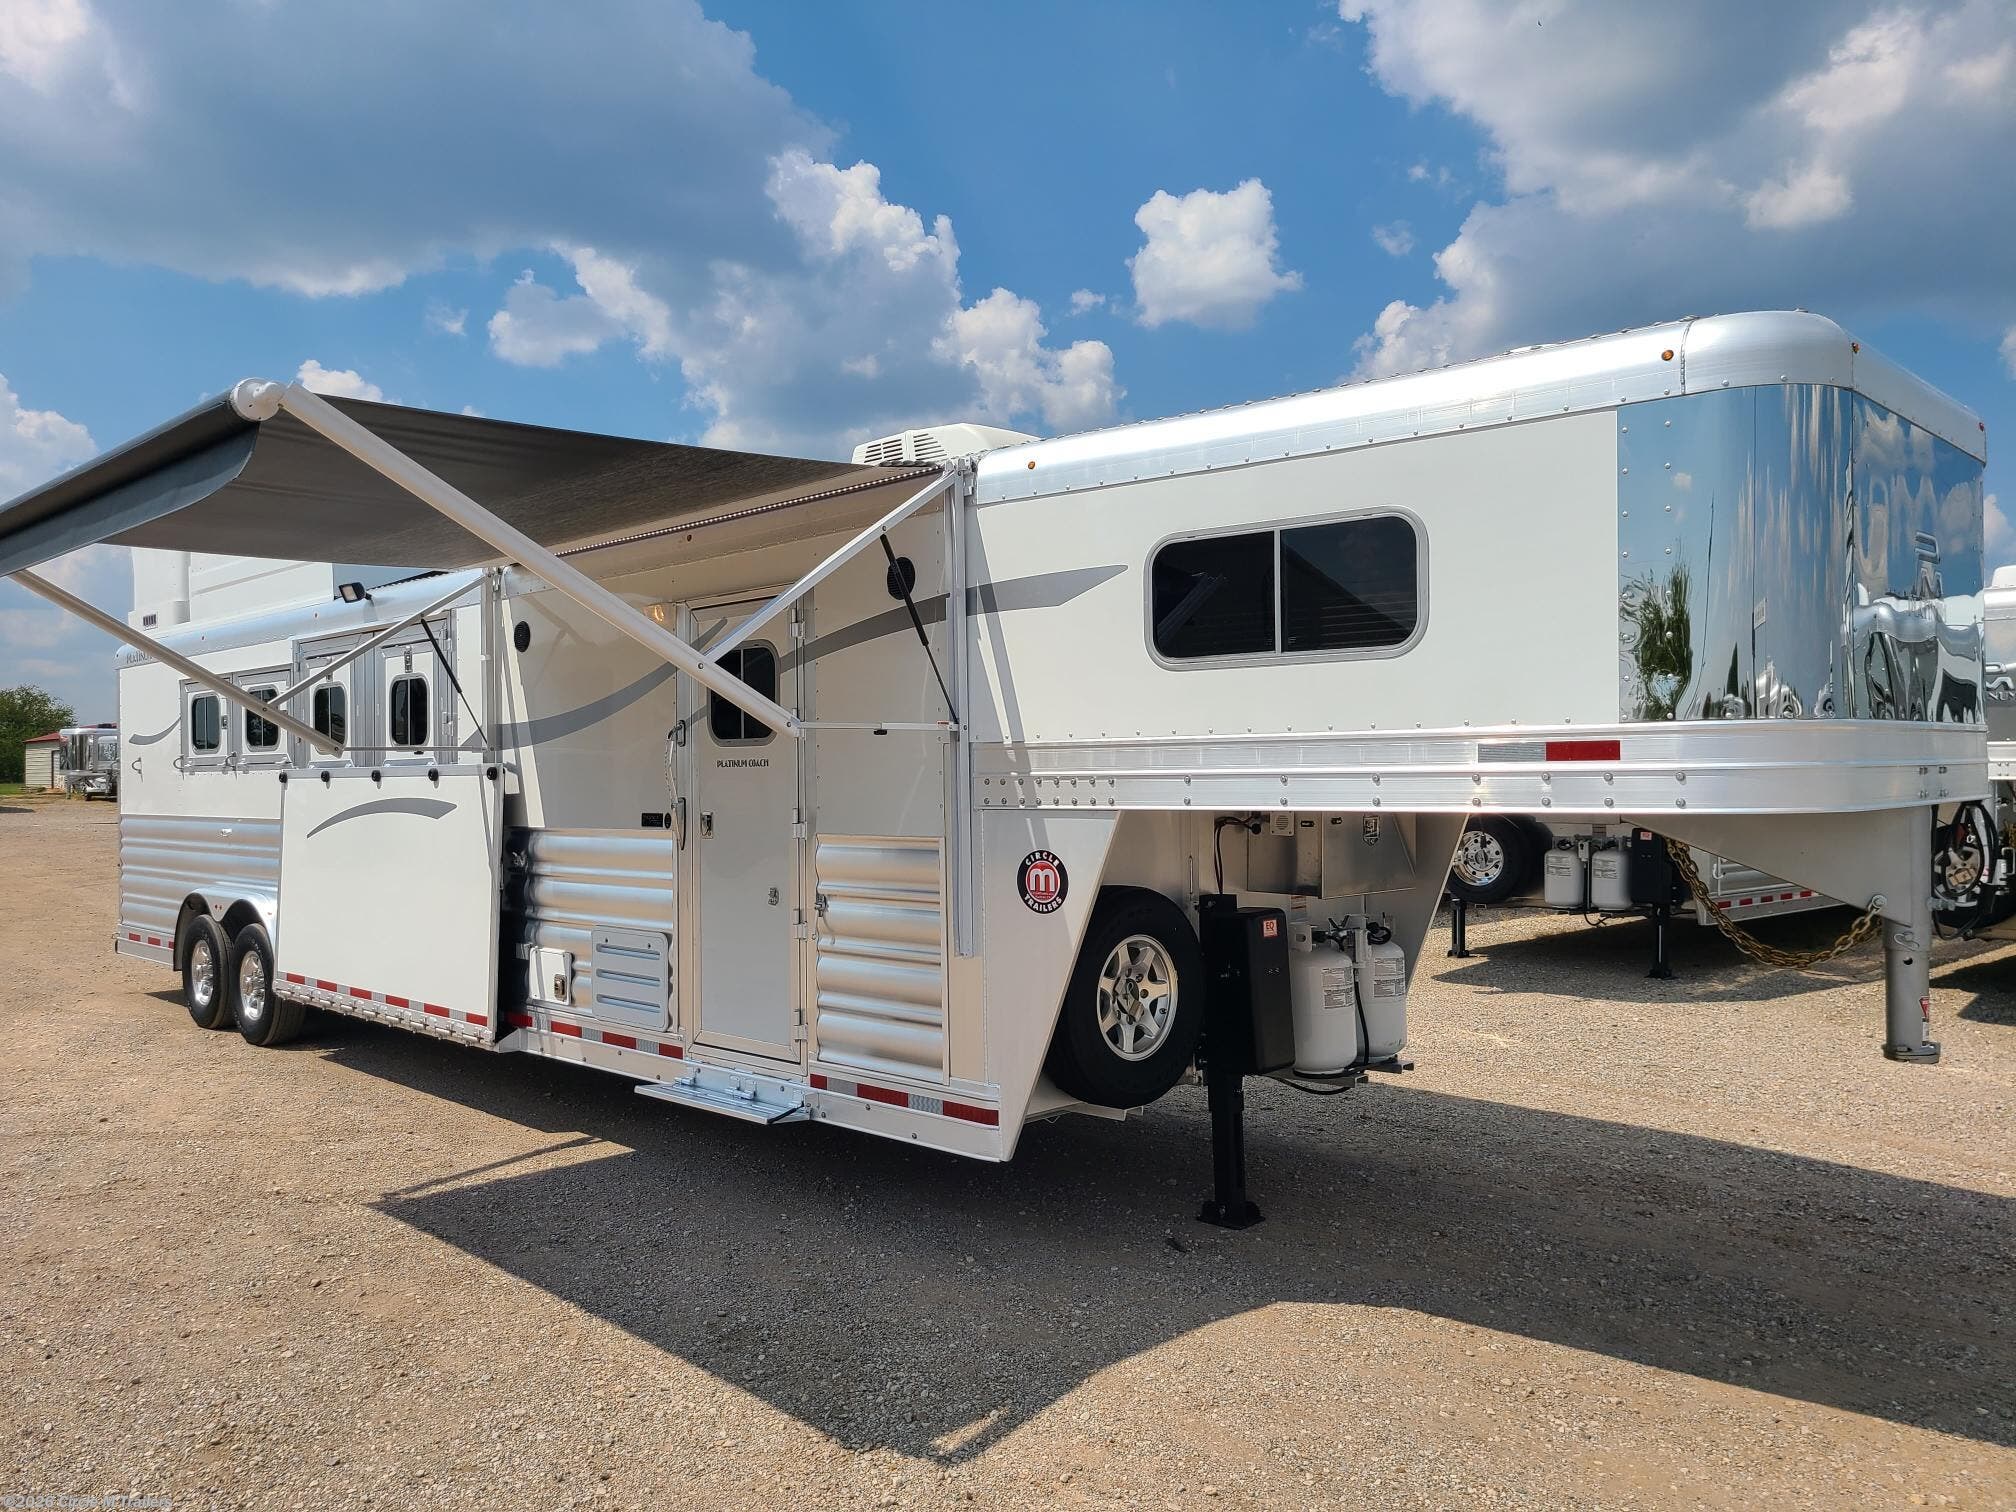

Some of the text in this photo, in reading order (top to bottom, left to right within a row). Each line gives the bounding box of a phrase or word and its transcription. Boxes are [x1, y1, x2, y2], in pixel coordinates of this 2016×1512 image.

[716, 758, 769, 768] PLATINUM COACH
[1025, 851, 1060, 866] CIRCLE
[1024, 893, 1063, 912] TRAILERS
